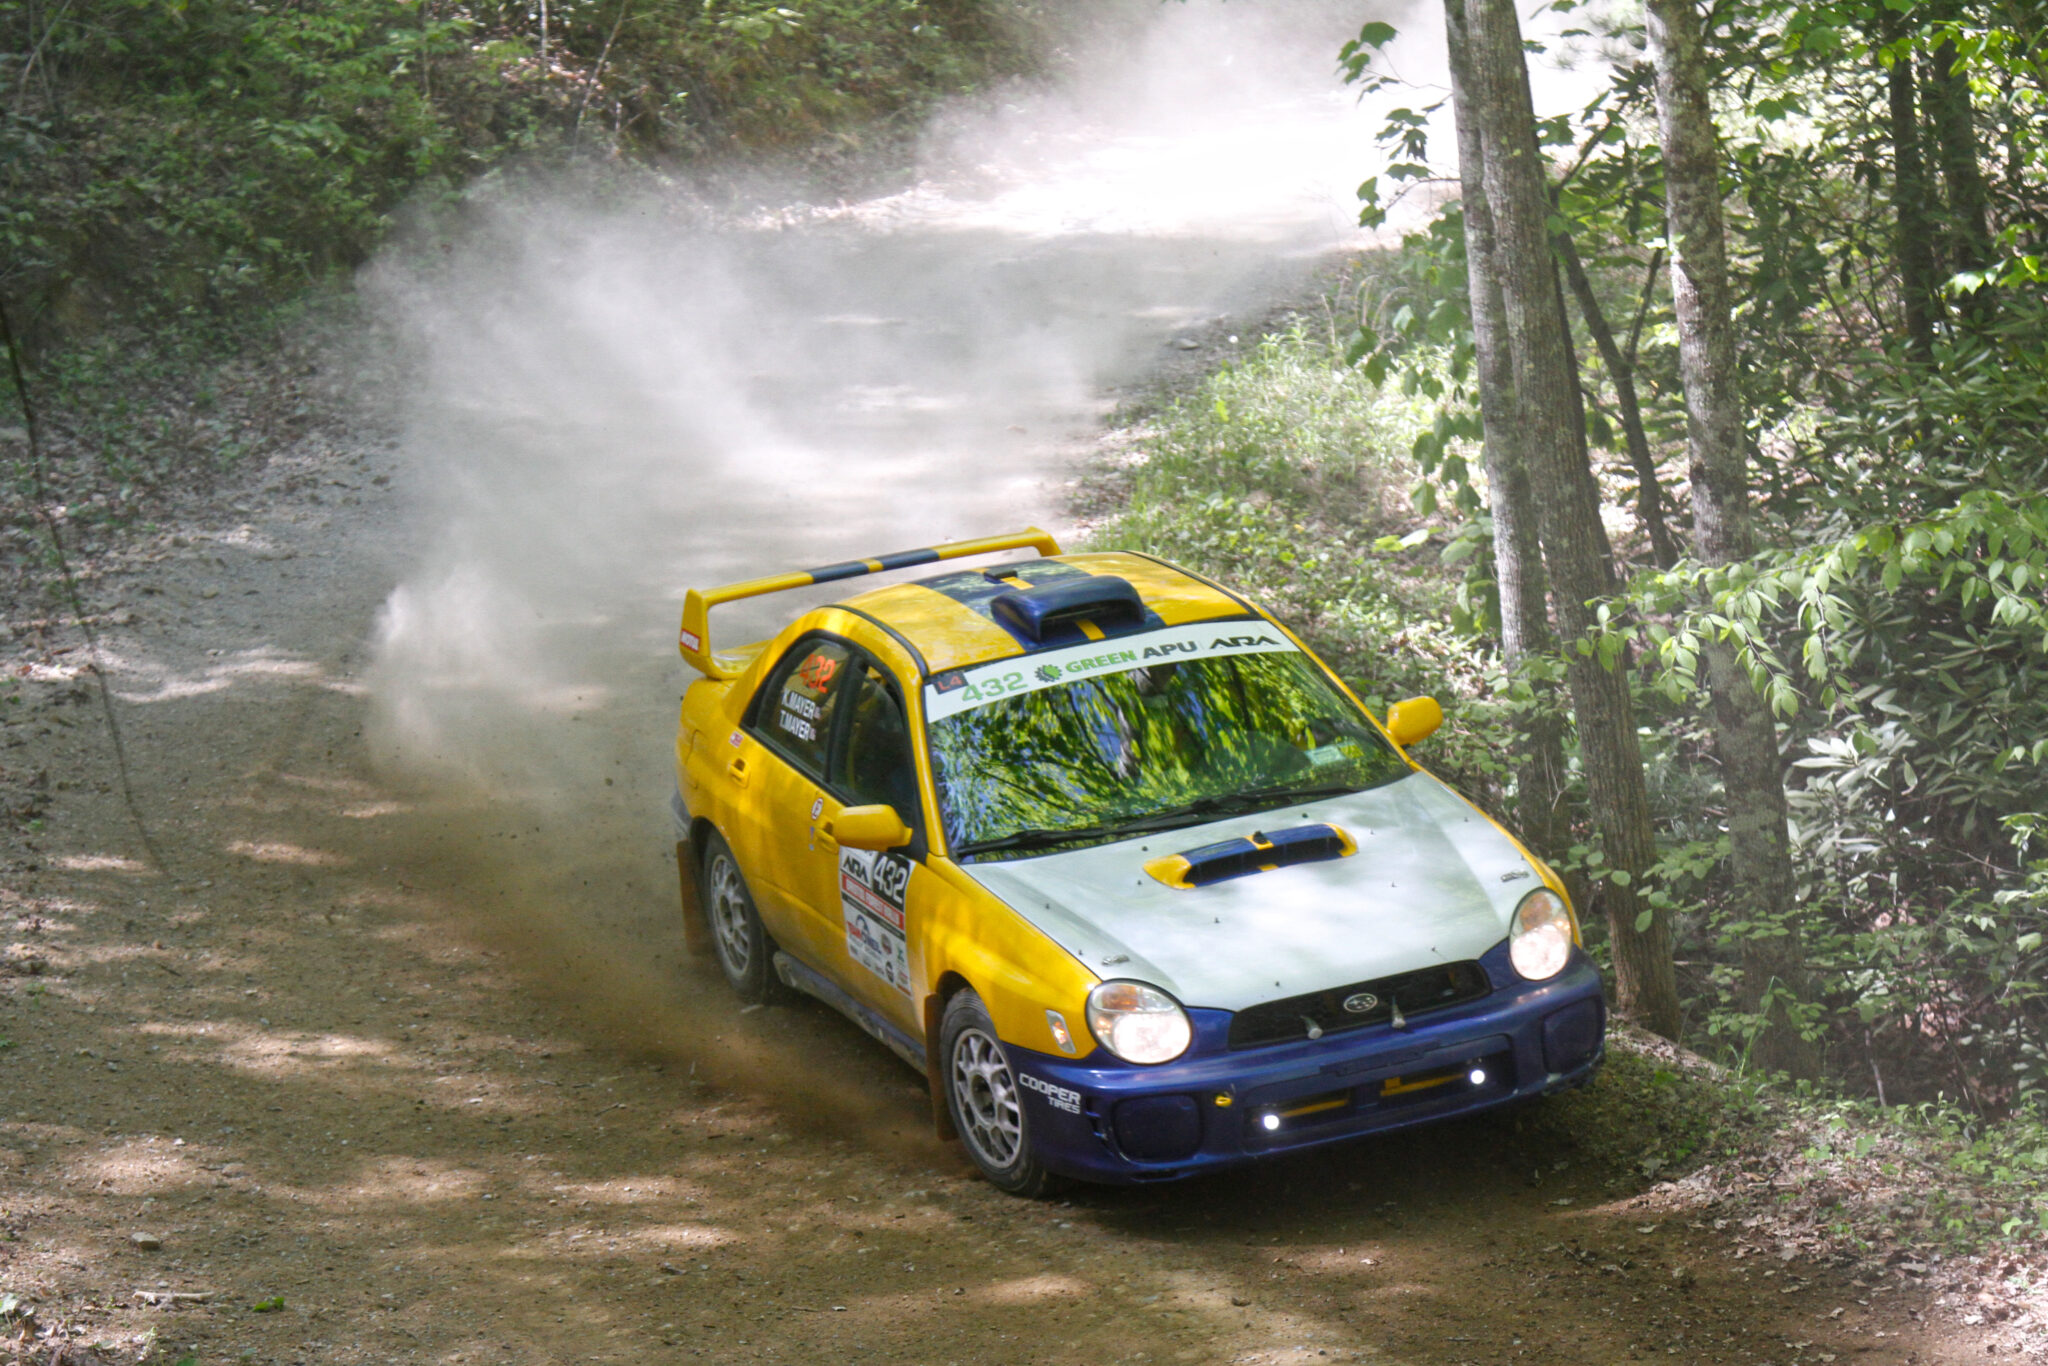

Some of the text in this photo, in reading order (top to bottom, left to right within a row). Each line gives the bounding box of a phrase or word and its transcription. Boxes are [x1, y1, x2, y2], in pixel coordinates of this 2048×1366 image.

[799, 653, 836, 694] 432
[962, 635, 1282, 701] 432 GREEN APU ARA
[842, 855, 869, 884] ARA
[873, 855, 909, 905] 432
[1019, 1073, 1081, 1105] COOPER
[1047, 1096, 1081, 1115] TIRES
